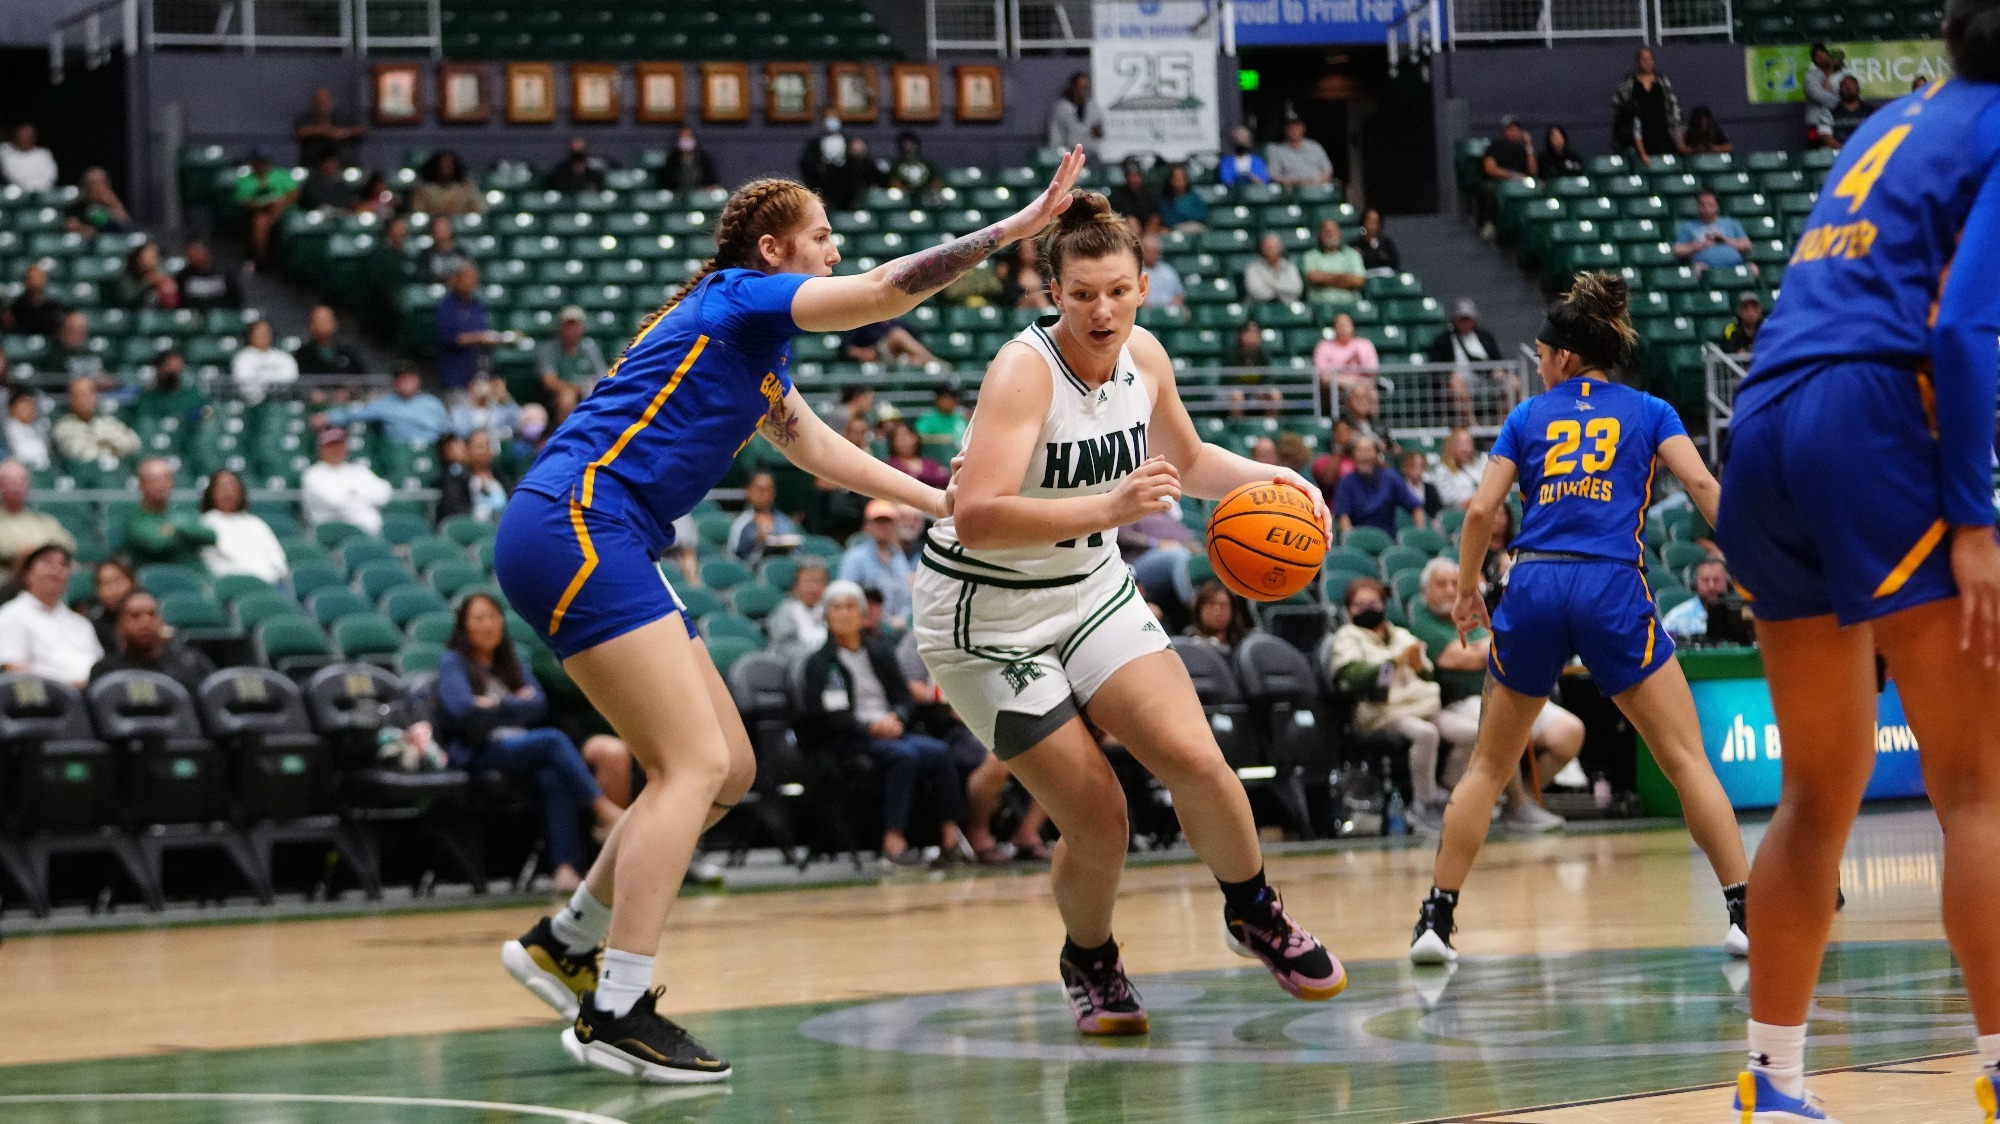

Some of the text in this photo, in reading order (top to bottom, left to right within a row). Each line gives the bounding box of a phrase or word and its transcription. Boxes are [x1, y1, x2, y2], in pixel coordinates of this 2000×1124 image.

[1233, 0, 1280, 25] roud
[1113, 50, 1195, 99] 25
[1844, 54, 1953, 84] ERICAN
[1834, 124, 1913, 214] 4
[1543, 417, 1621, 477] 23
[1265, 527, 1311, 551] EVO
